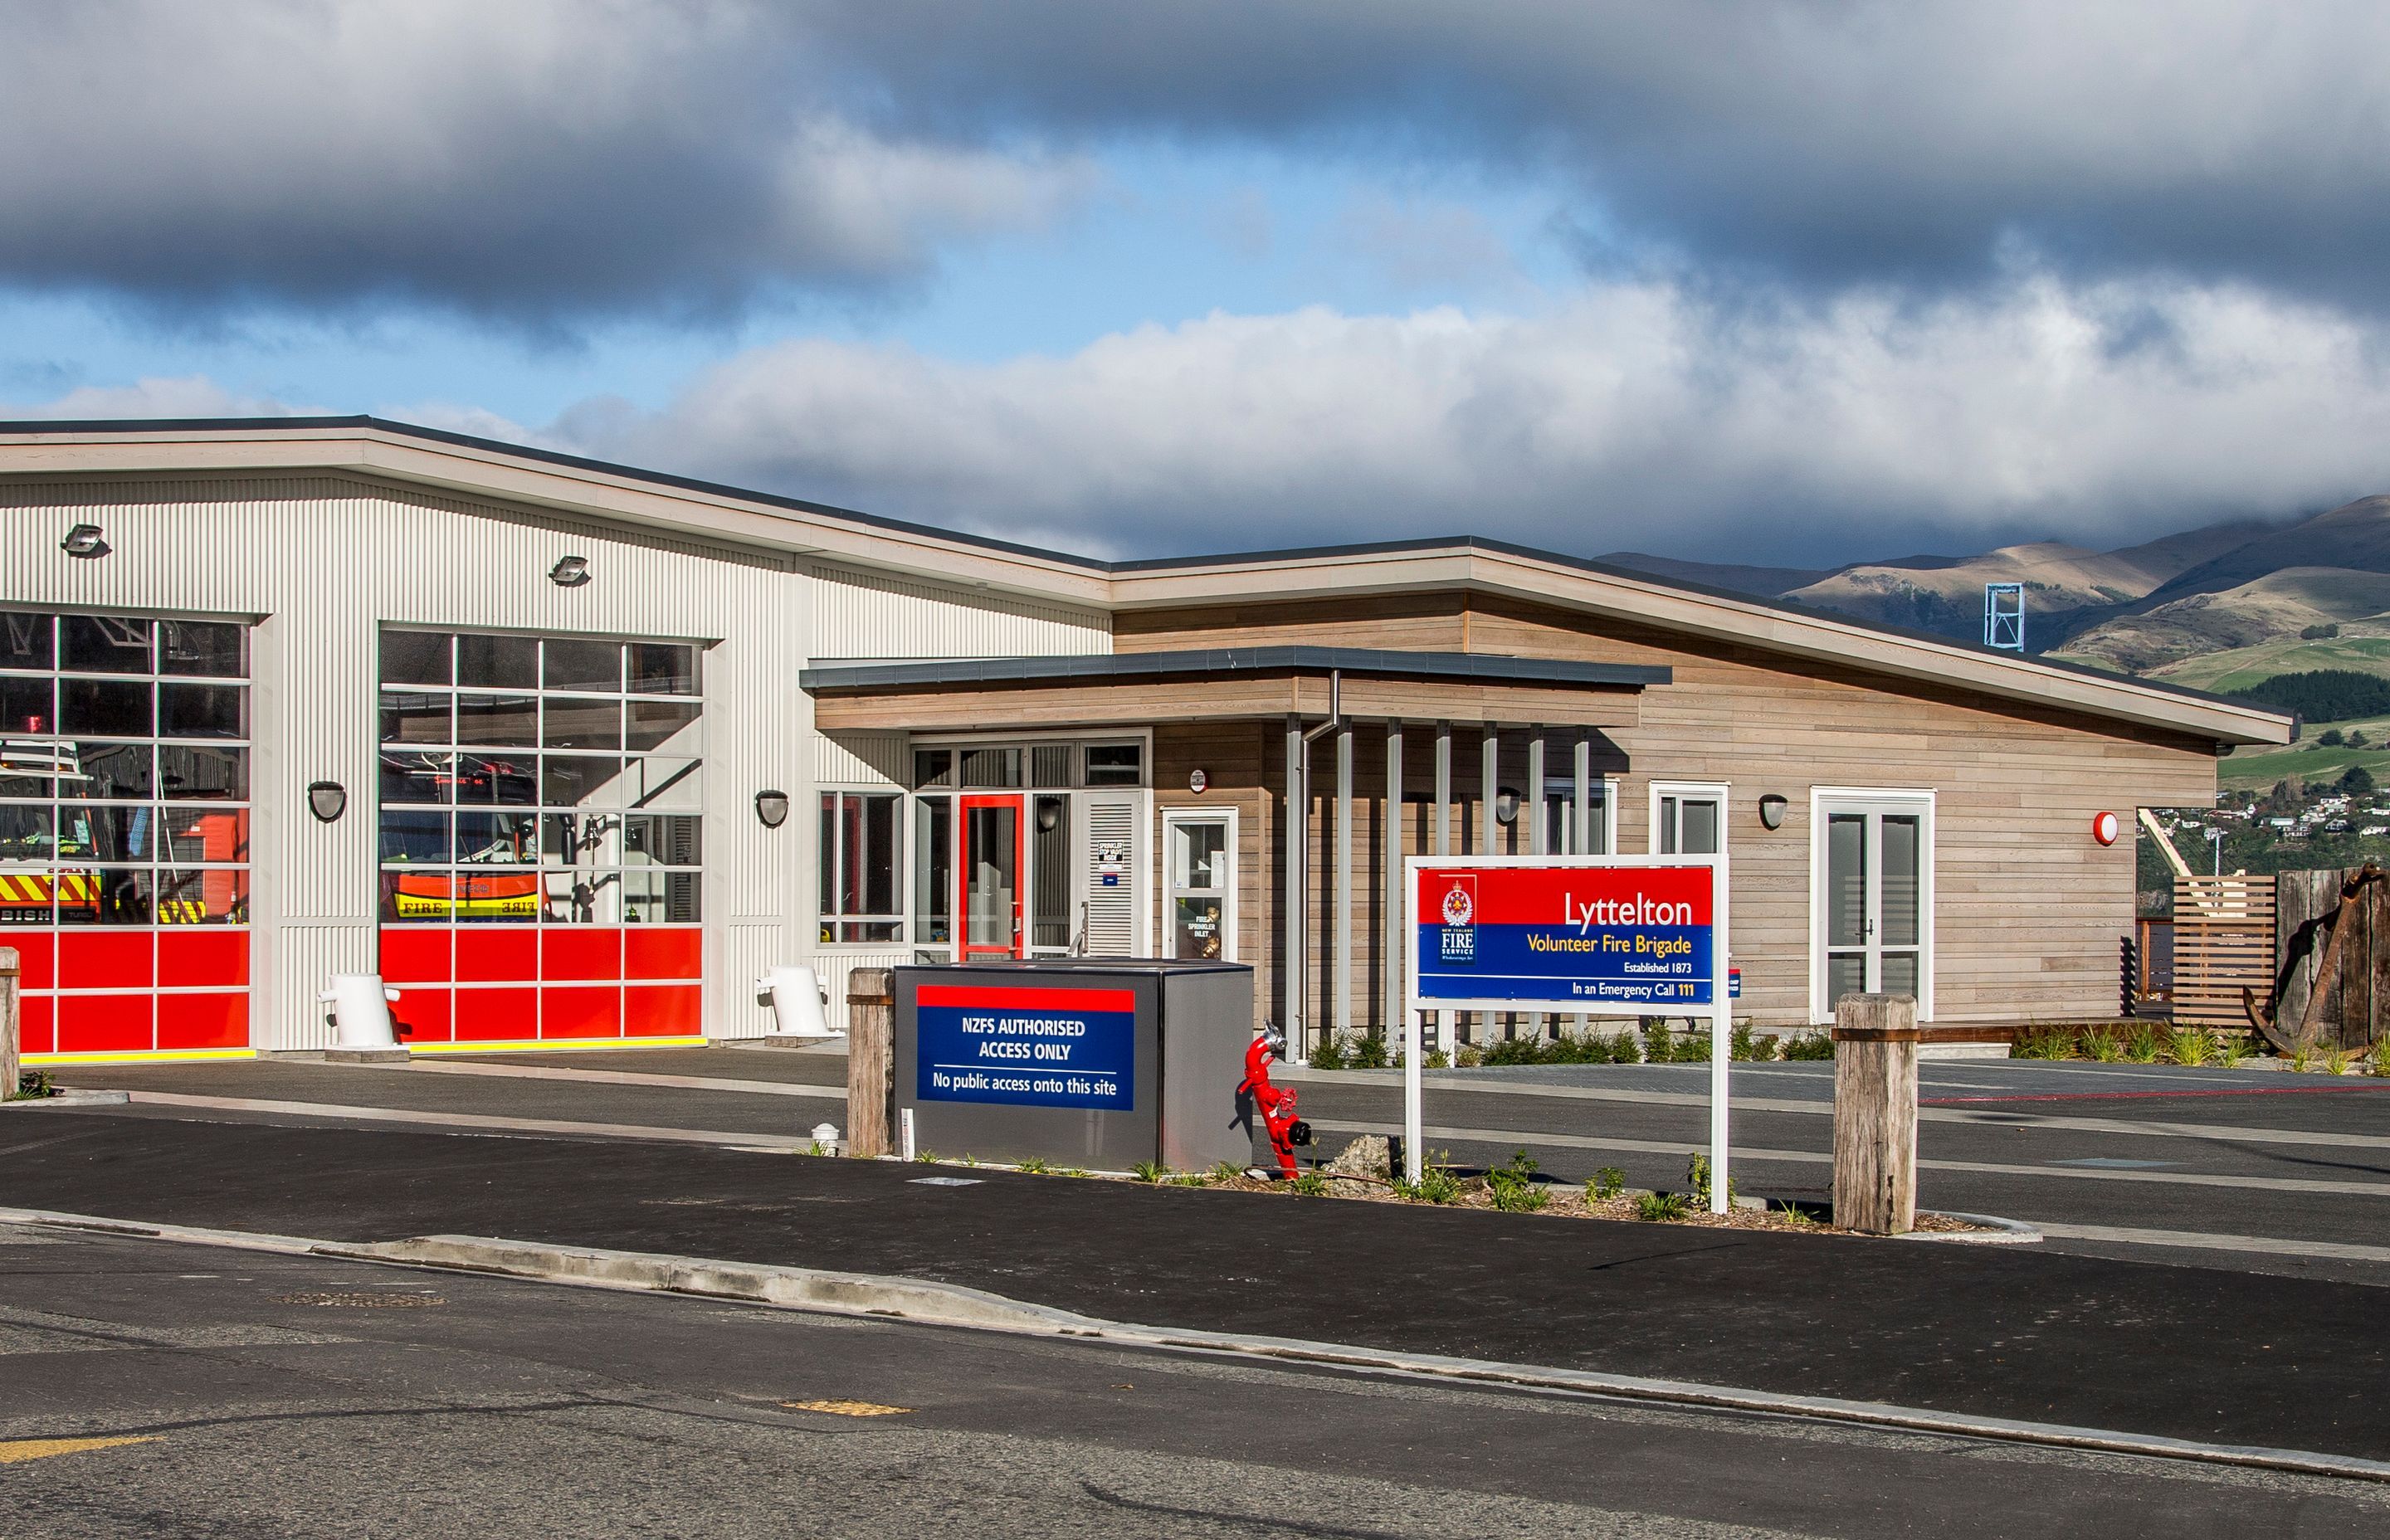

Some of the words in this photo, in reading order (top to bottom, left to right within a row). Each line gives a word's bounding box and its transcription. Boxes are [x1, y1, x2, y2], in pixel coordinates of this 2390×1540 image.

[1, 910, 54, 921] BISH
[403, 903, 442, 914] FIRE
[1565, 892, 1691, 935] Lyttelton
[1441, 933, 1474, 948] FIRE
[1527, 933, 1597, 952] Volunteer
[1602, 934, 1631, 953] Fire
[1636, 934, 1692, 958] Brigade
[1624, 962, 1669, 972] Established
[1672, 962, 1692, 973] 1873
[1573, 982, 1582, 994] In
[1584, 985, 1596, 995] an
[1599, 982, 1652, 999] Emergency
[1655, 983, 1674, 996] Call
[1678, 984, 1694, 996] 111
[963, 1017, 995, 1034] NZFS
[997, 1019, 1085, 1036] AUTHORISED
[978, 1041, 1031, 1059] ACCESS
[1034, 1043, 1071, 1060] ONLY
[933, 1072, 950, 1087] No
[954, 1073, 989, 1091] public
[993, 1079, 1030, 1091] access
[1033, 1079, 1064, 1093] onto
[1067, 1077, 1090, 1094] this
[1093, 1079, 1116, 1095] site
